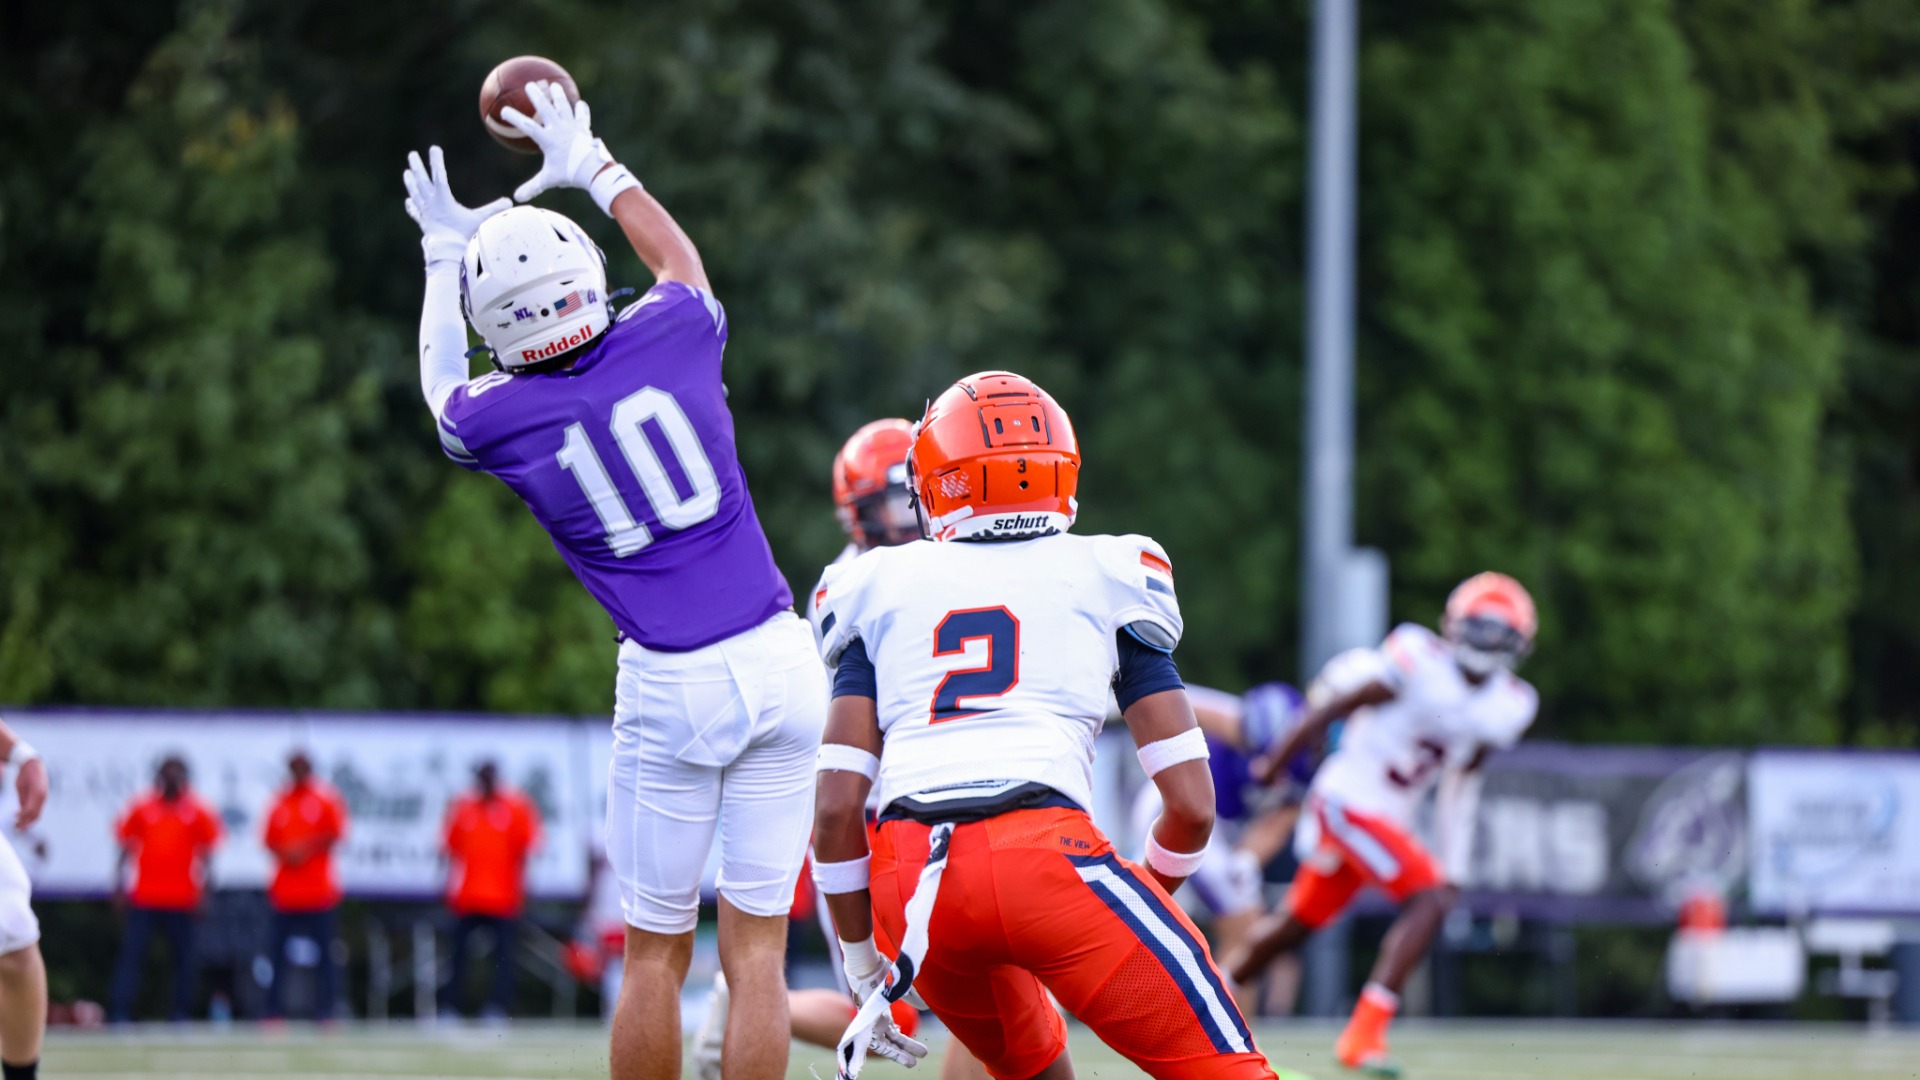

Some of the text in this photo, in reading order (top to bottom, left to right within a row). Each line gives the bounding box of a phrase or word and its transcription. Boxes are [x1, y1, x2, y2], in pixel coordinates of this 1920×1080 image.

[522, 324, 593, 362] Riddell
[556, 385, 722, 558] 10
[1017, 458, 1027, 473] 3
[993, 514, 1049, 530] schutt
[929, 605, 1020, 725] 2
[1060, 836, 1072, 846] THE
